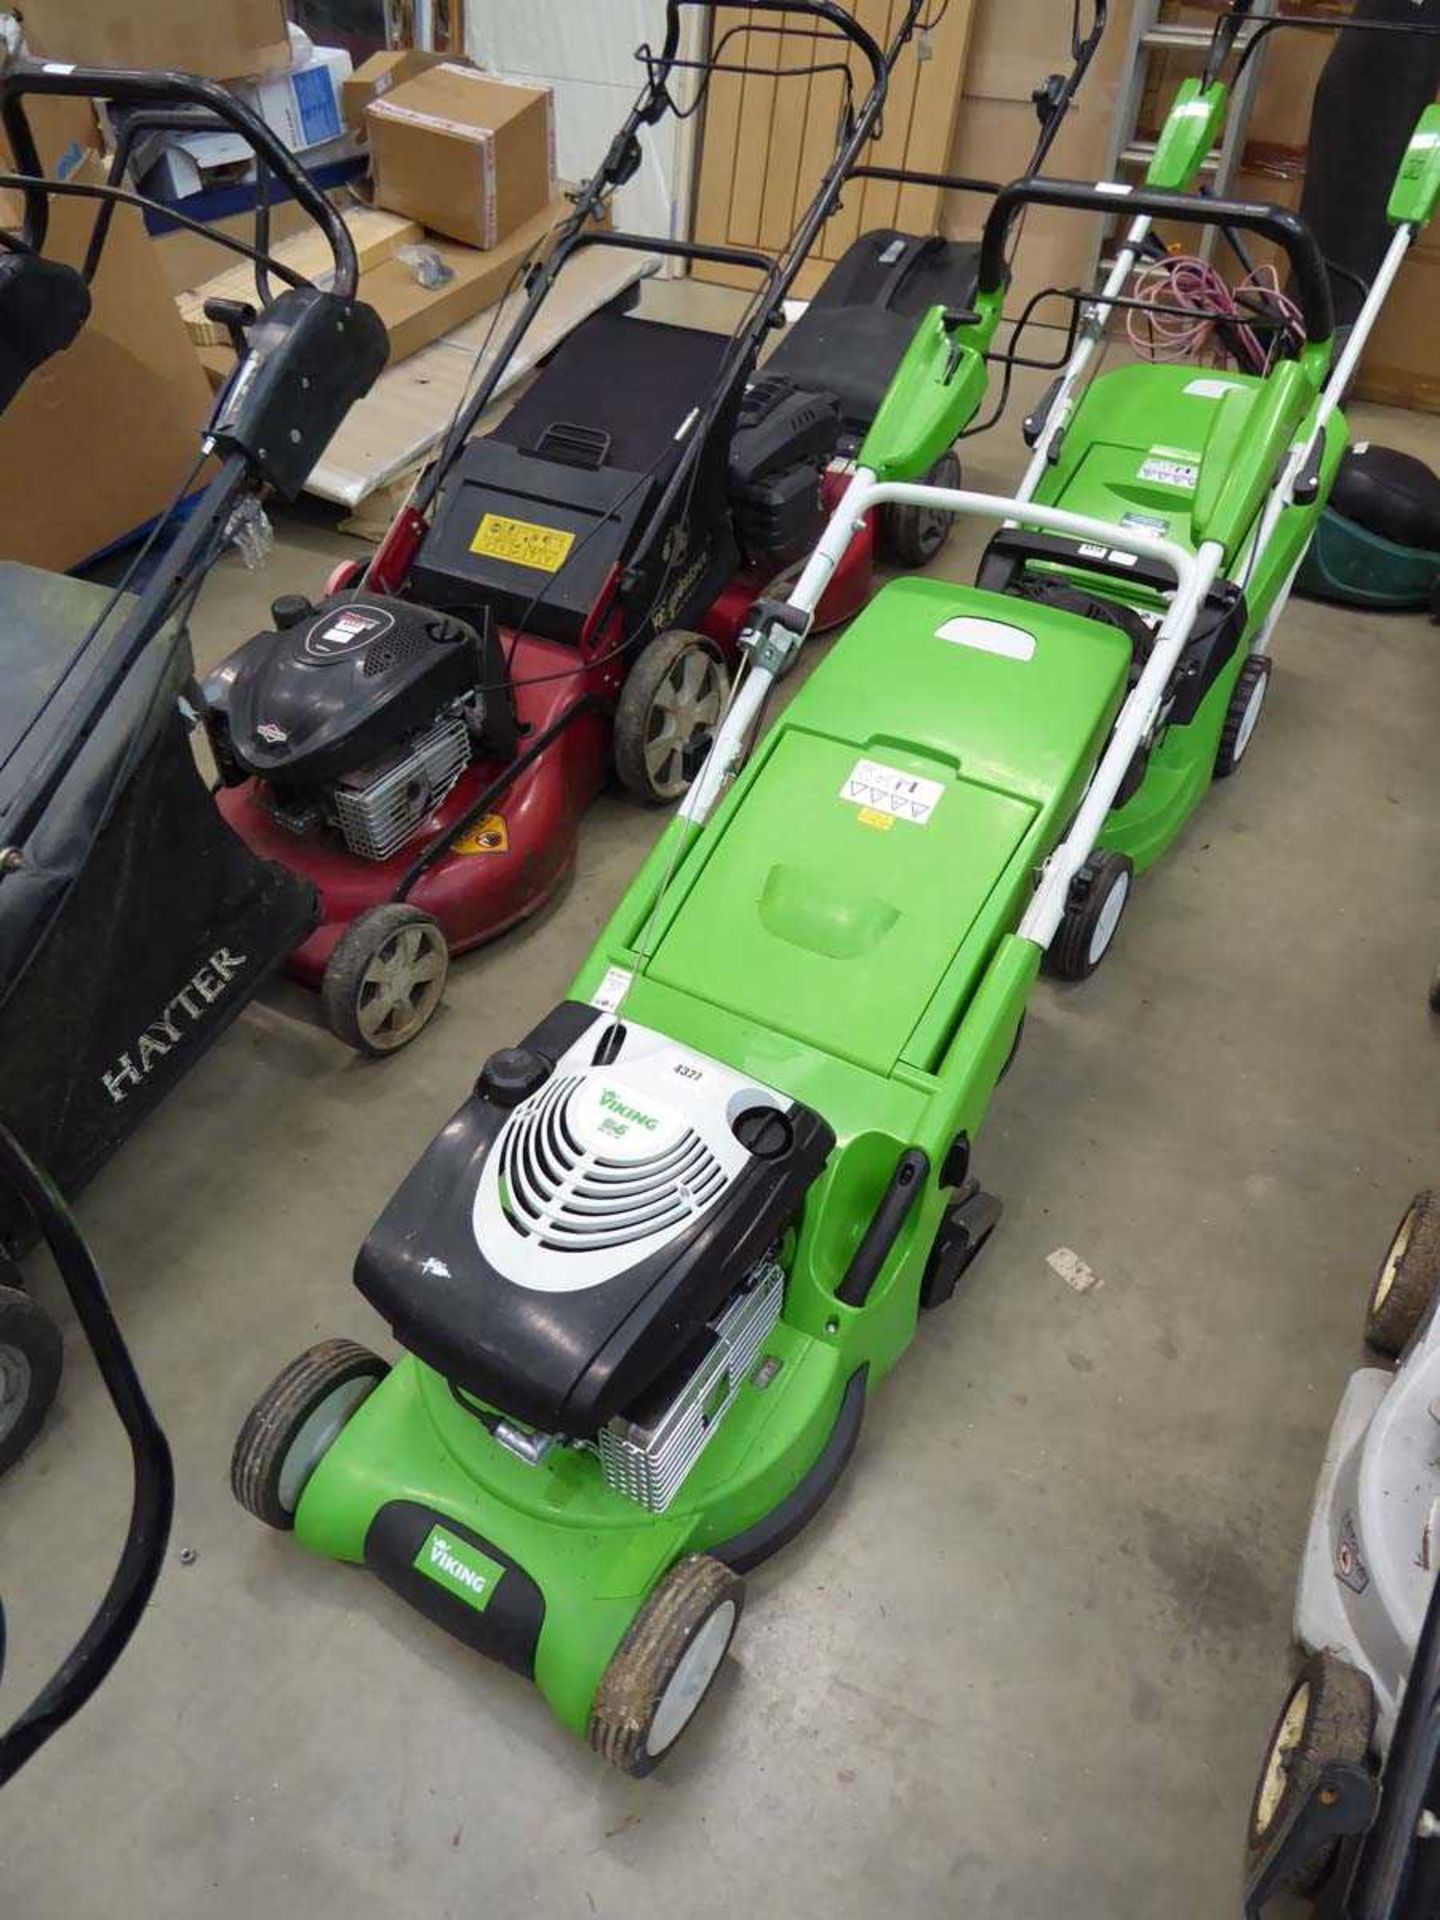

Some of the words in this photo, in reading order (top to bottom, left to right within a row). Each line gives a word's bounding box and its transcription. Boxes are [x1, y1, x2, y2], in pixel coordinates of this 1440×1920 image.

[101, 947, 247, 1103] HAYTER
[598, 1090, 660, 1132] VIKING
[430, 1542, 487, 1594] VIKING
